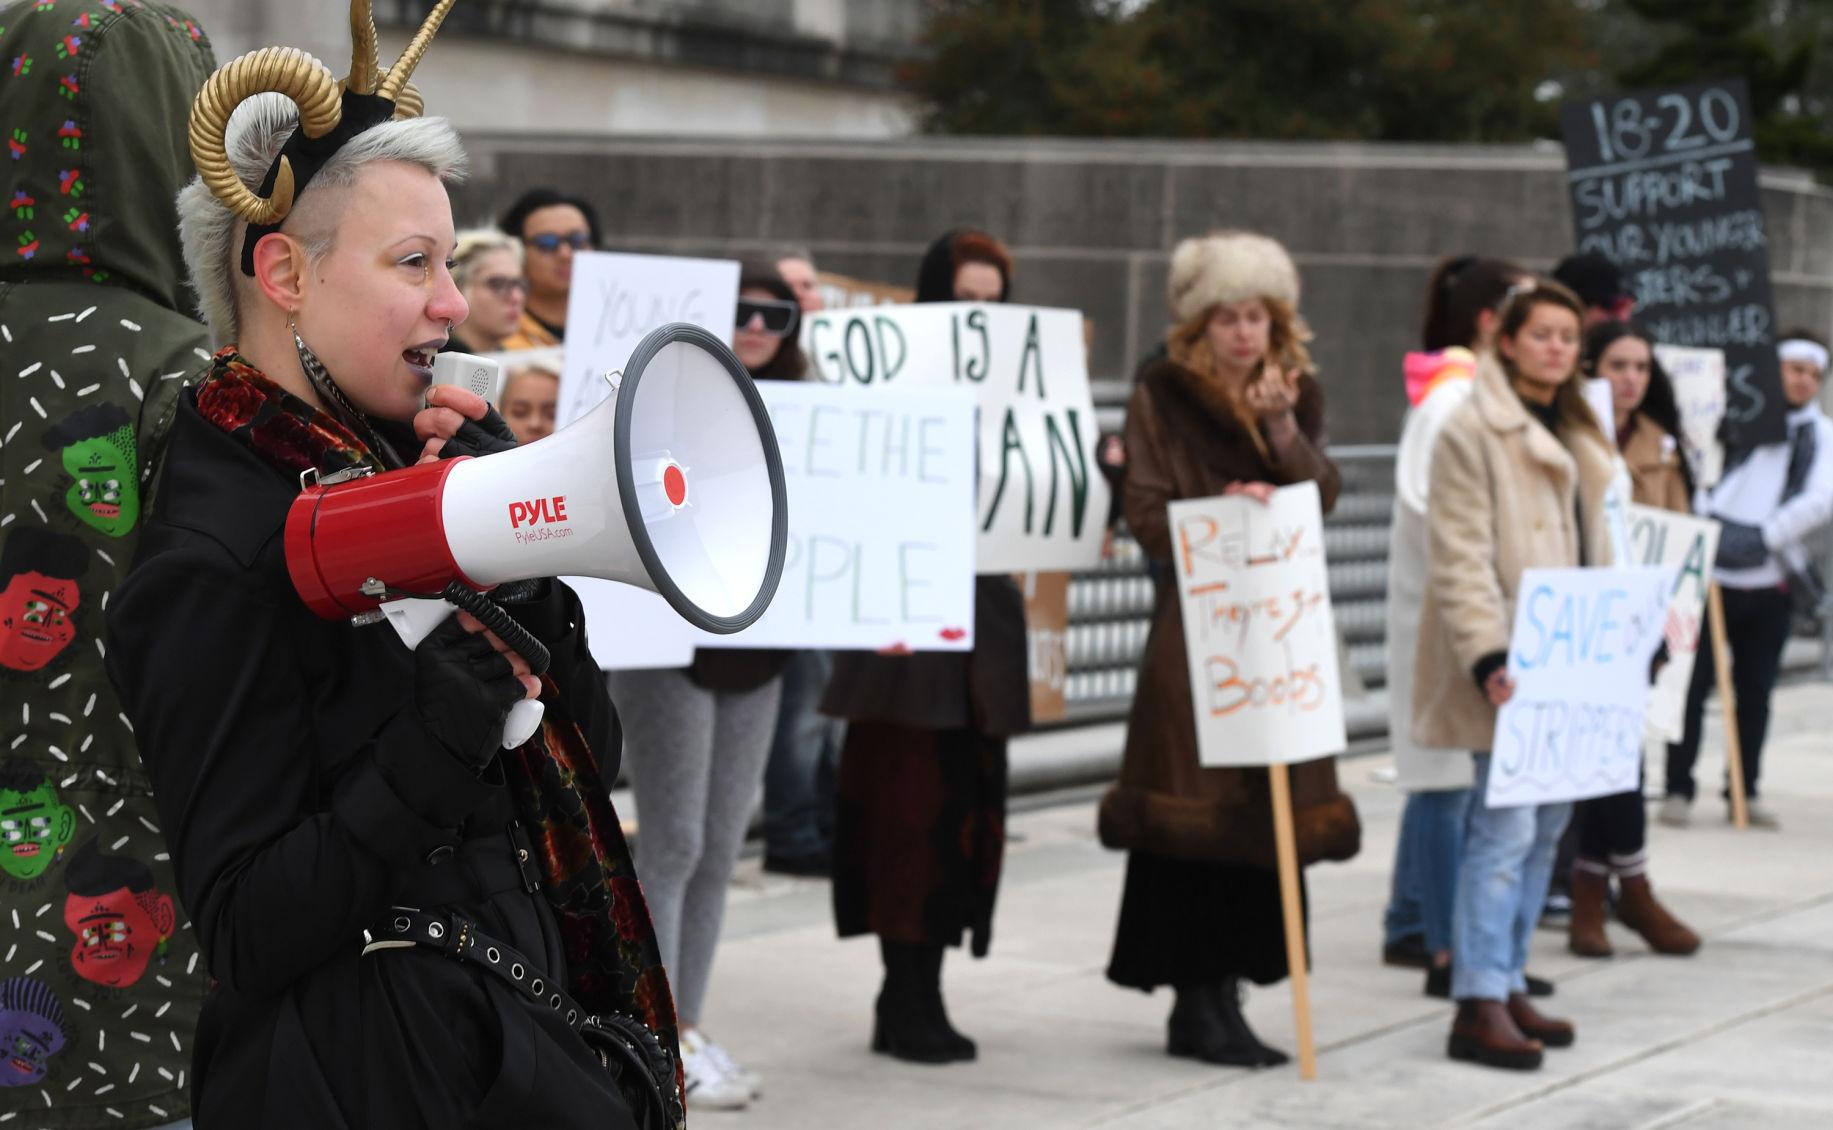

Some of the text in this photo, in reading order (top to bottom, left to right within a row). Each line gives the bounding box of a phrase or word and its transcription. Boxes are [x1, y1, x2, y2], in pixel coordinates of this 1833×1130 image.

[1591, 88, 1740, 161] 18-20
[1575, 158, 1733, 229] SUPPORT
[808, 309, 1046, 399] GOD IS A
[852, 408, 949, 485] THE
[508, 496, 568, 529] PYLE
[515, 528, 574, 545] PyleUSA.com
[1515, 584, 1627, 670] SAVE
